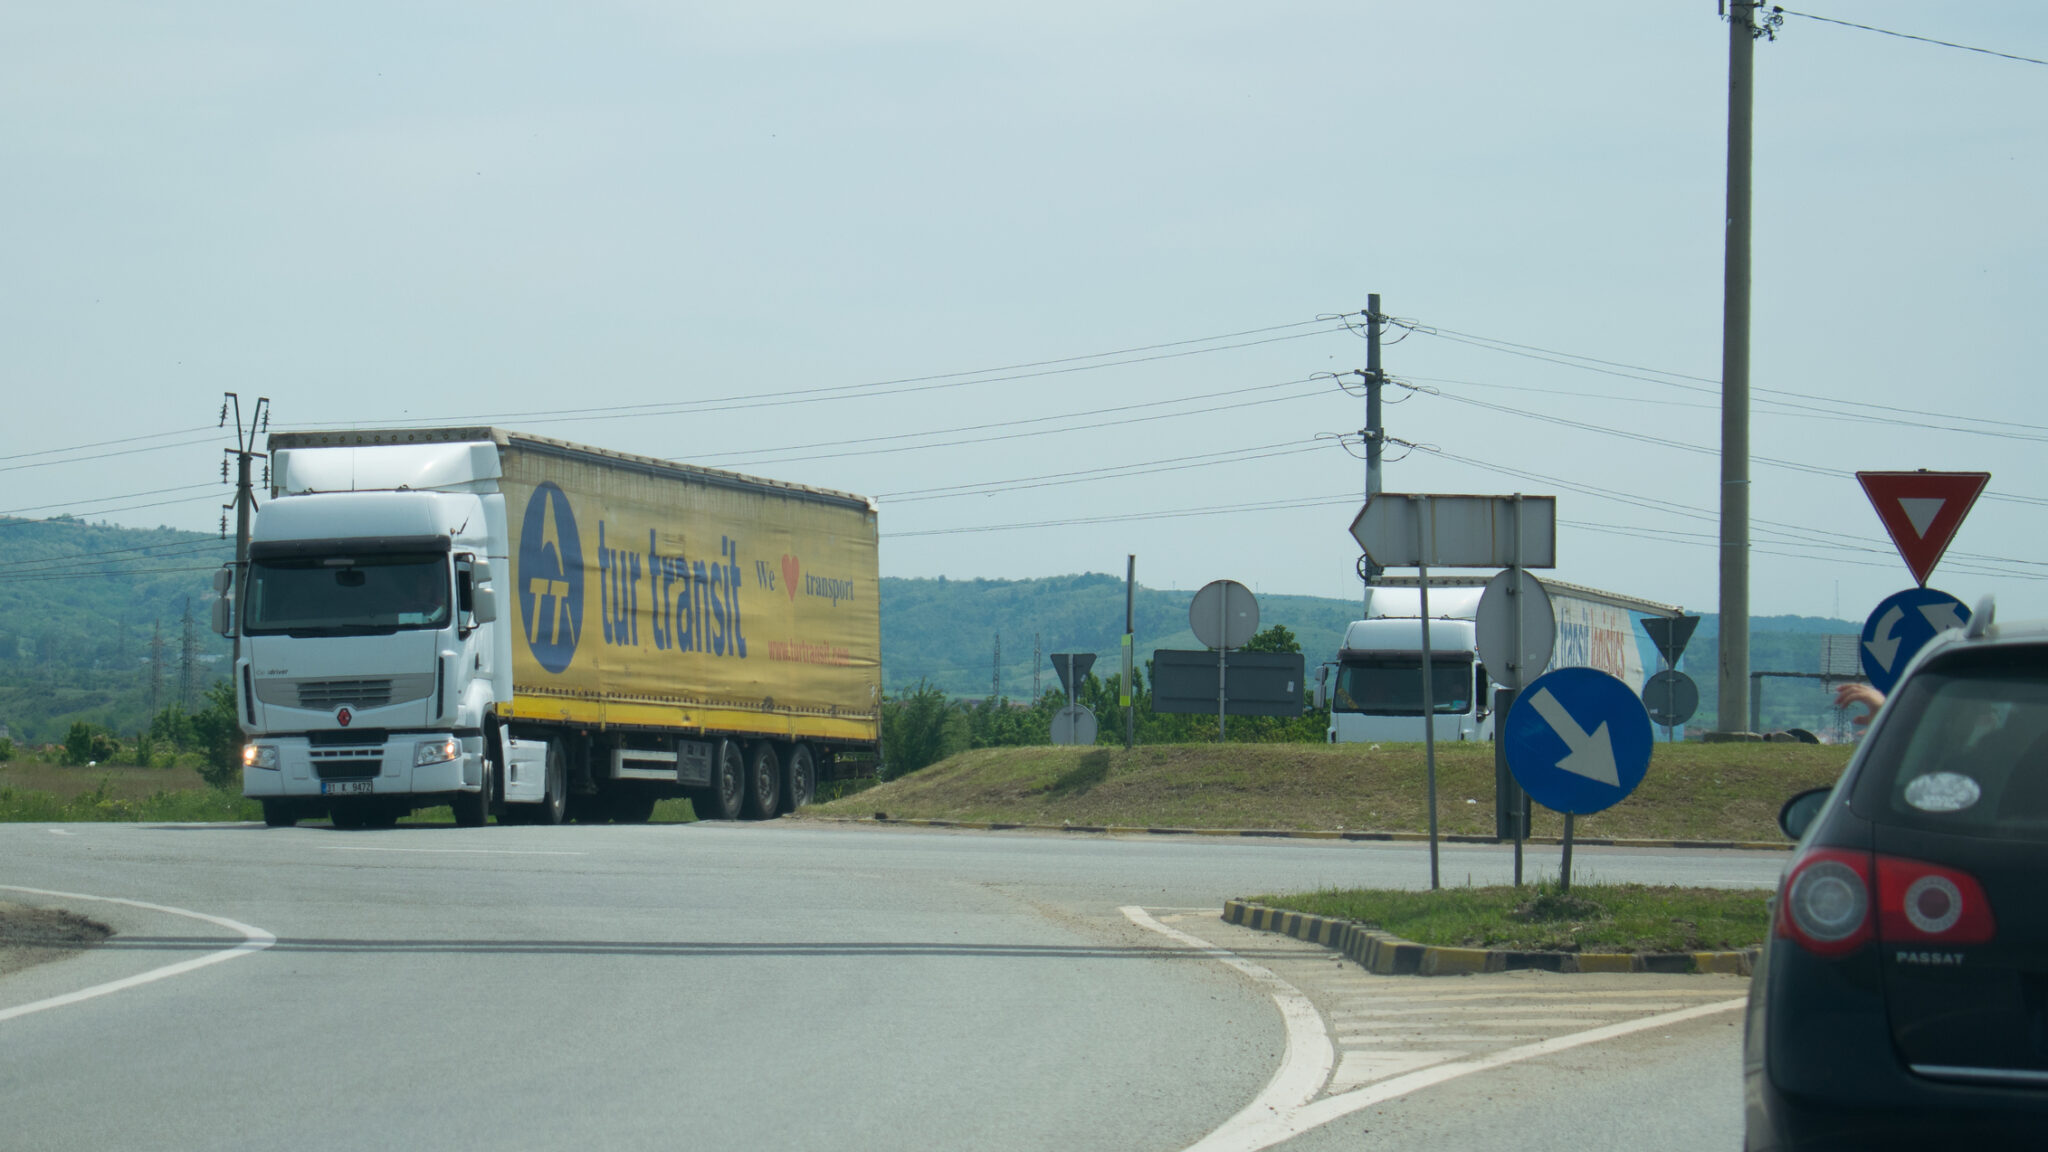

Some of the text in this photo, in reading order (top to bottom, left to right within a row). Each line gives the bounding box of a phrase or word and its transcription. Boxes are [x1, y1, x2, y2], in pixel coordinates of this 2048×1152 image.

[598, 520, 747, 659] tur transit
[755, 560, 854, 607] We transport
[1896, 951, 1964, 964] PASSAT
